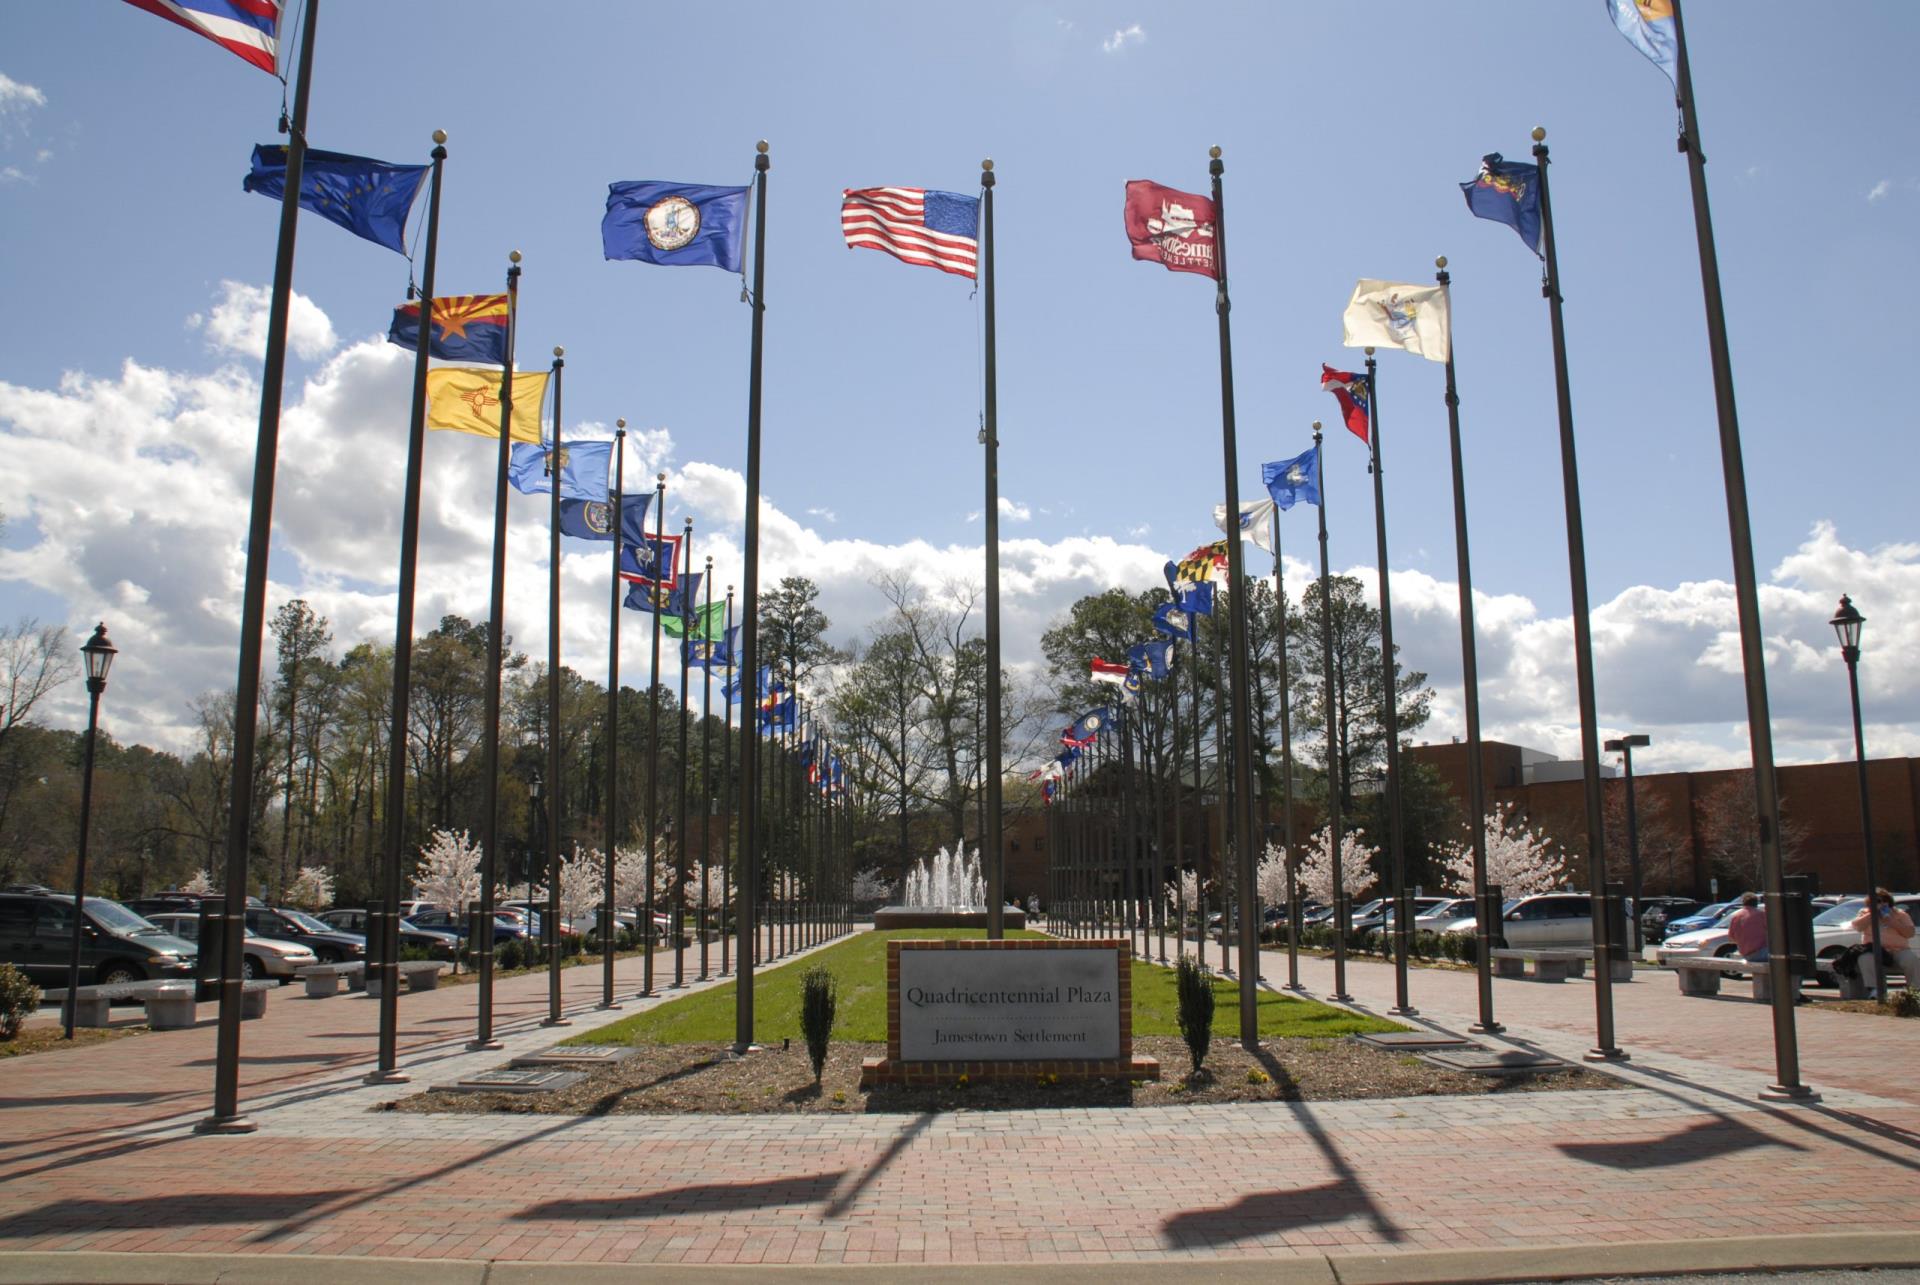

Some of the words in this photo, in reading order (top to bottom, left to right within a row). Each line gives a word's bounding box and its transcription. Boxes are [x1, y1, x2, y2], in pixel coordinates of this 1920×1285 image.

[907, 986, 1060, 1007] Quadricentennial
[1067, 986, 1112, 1003] Plaza
[932, 1029, 1008, 1045] Jamestown
[1014, 1029, 1087, 1043] Settlement
